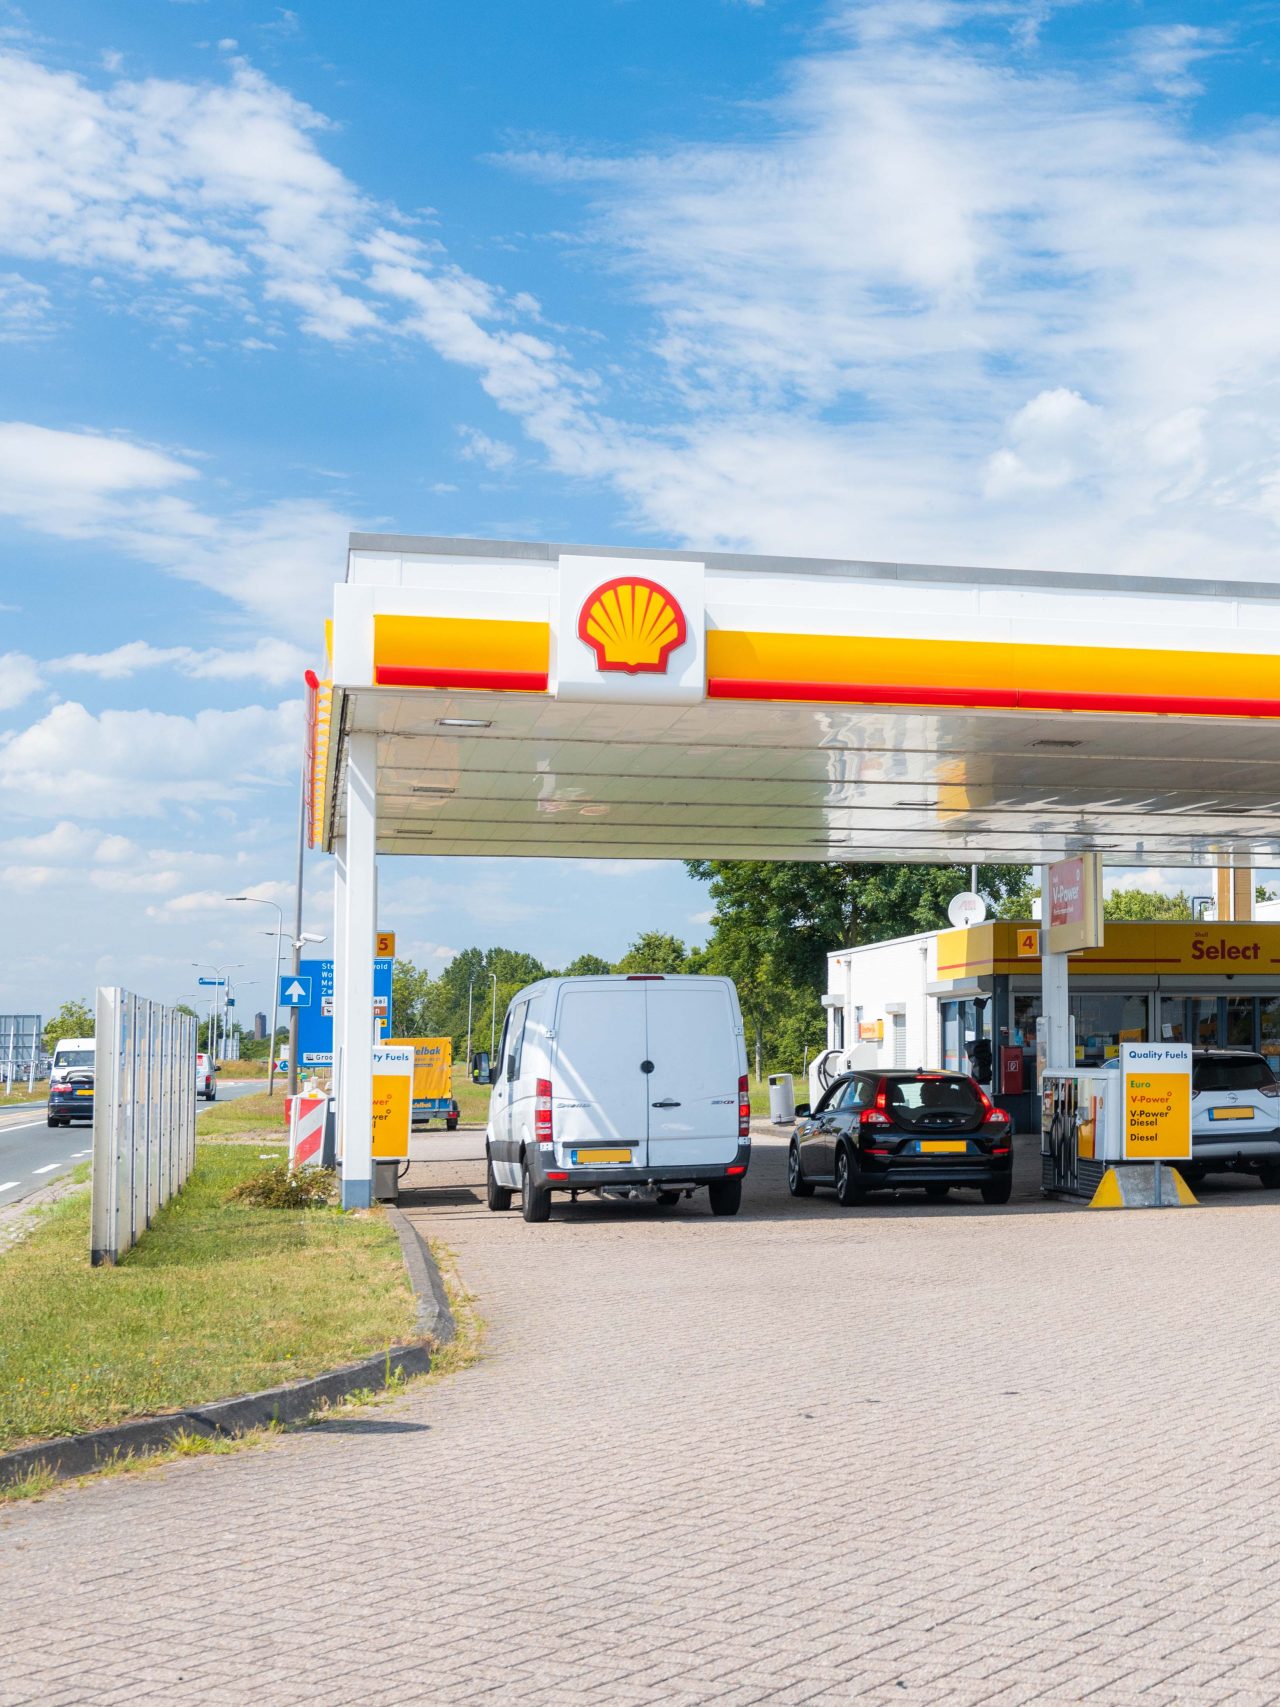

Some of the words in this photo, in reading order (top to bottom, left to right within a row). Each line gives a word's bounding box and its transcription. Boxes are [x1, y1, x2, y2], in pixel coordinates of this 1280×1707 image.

[1053, 886, 1078, 904] V-Power
[378, 938, 388, 951] 5
[1022, 936, 1034, 950] 4
[1192, 939, 1260, 960] Select
[1129, 1050, 1162, 1060] Quality
[1165, 1050, 1188, 1059] Fuels
